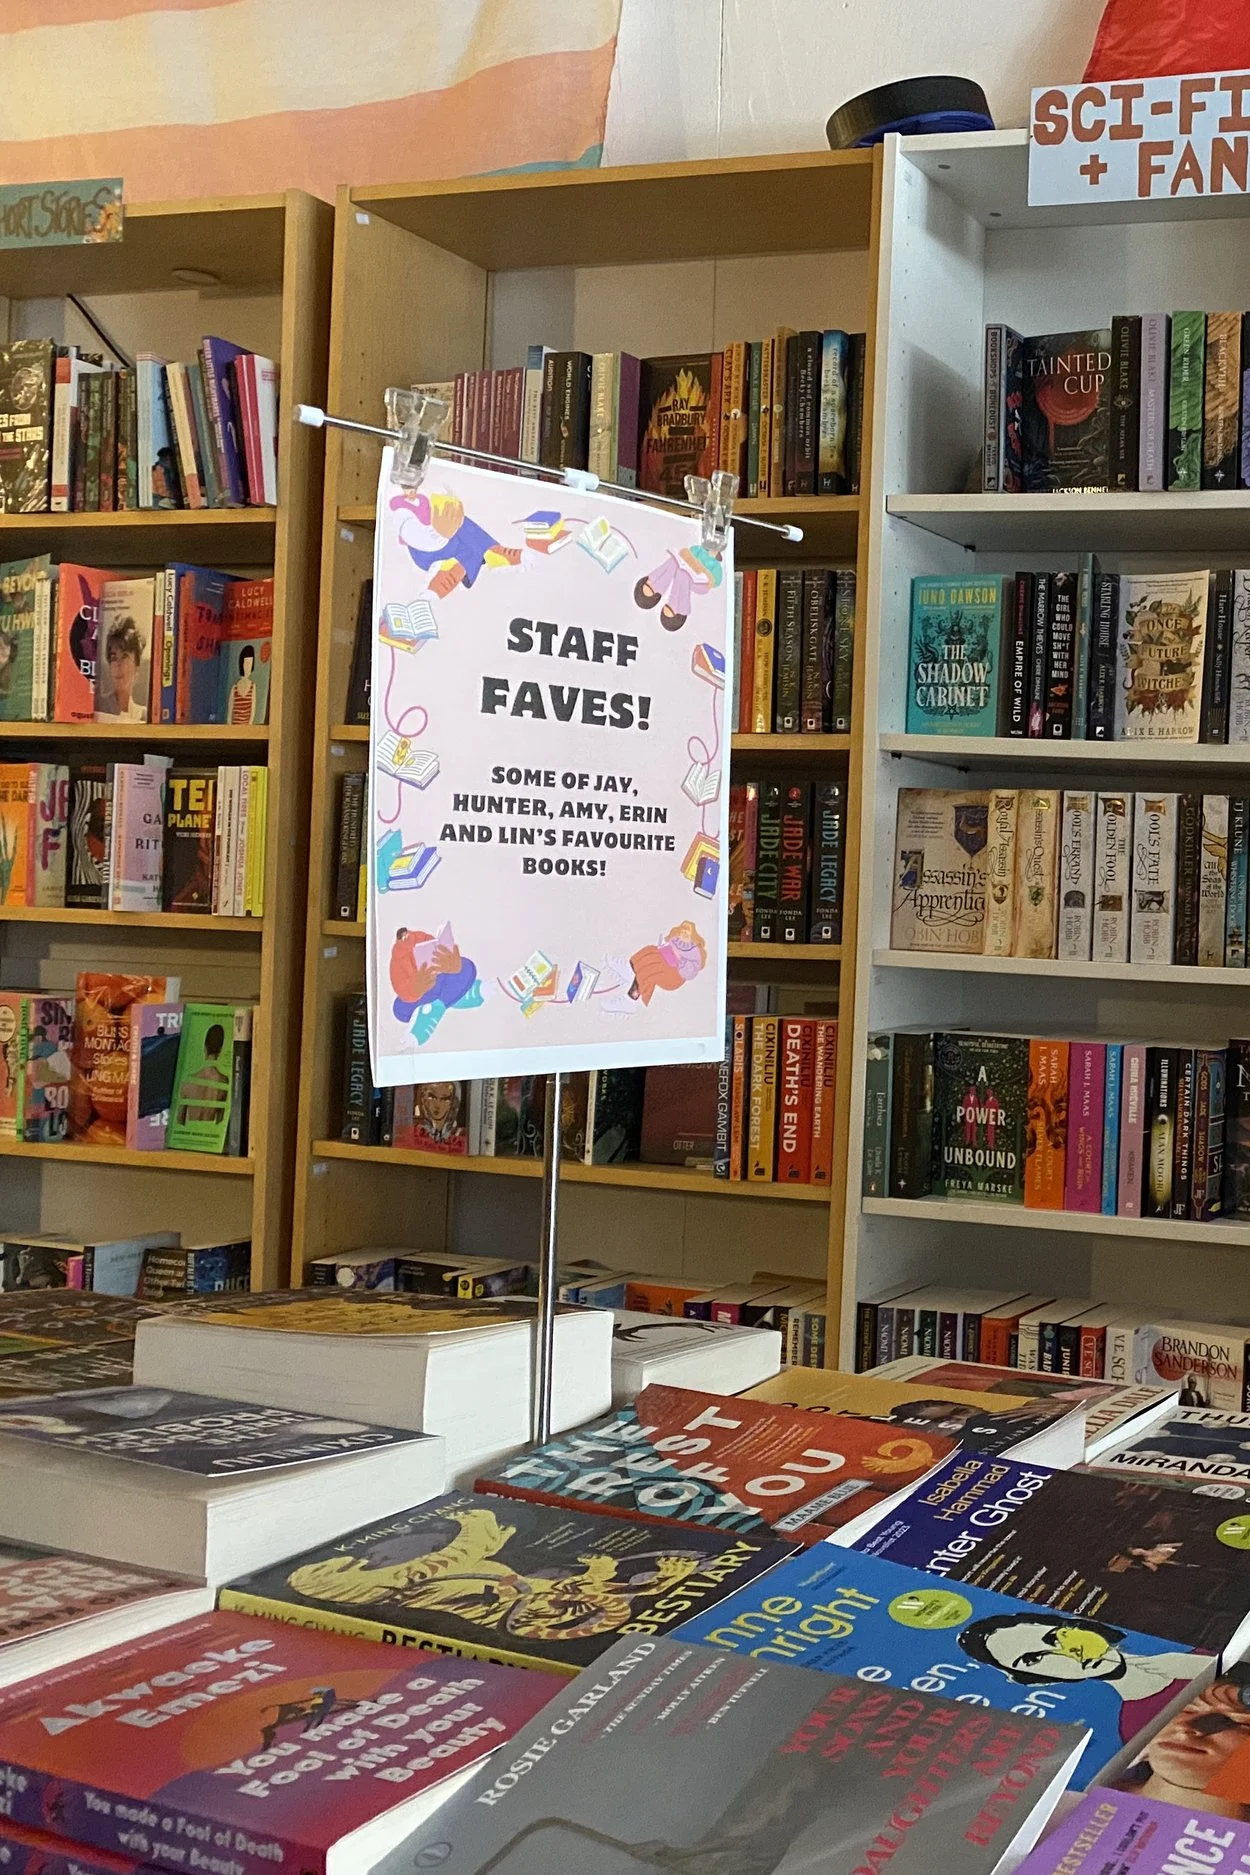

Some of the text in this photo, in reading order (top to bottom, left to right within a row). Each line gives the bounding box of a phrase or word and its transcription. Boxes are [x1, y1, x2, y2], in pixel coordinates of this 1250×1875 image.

[1079, 154, 1108, 185] +
[1026, 352, 1112, 378] TAINTED
[1063, 374, 1105, 395] CUP
[657, 410, 707, 426] BRADBURY
[673, 397, 690, 411] RAY
[507, 617, 639, 667] STAFF
[943, 644, 966, 660] THE
[917, 662, 989, 684] SHADOW
[1012, 640, 1024, 722] EMPIRE OF WILD
[480, 676, 652, 731] FAVES!
[915, 686, 989, 708] CABINET
[491, 766, 639, 797] SOME OF JAY,
[452, 794, 667, 824] HUNTER, AMY, ERIN
[440, 824, 676, 852] AND LIN'S FAVOURITE
[820, 810, 840, 902] JADE LEGACY
[522, 858, 607, 877] BOOKS!
[783, 1024, 801, 1153] DEATH'S END
[977, 1066, 987, 1083] A
[956, 1106, 1006, 1126] POWER
[944, 1147, 1017, 1170] UNBOUND
[945, 1179, 1013, 1194] FREYA MARSKE
[1153, 1352, 1238, 1381] SANDERSON
[1161, 1336, 1231, 1362] BRANDON
[499, 1420, 658, 1482] THE
[564, 1406, 742, 1499] REST
[636, 1461, 735, 1509] OF
[701, 1447, 847, 1520] YOU
[918, 1459, 984, 1506] Isabella
[933, 1463, 1011, 1522] Hammad
[926, 1471, 1053, 1577] nter Ghost
[618, 1540, 763, 1640] BESTIARY
[39, 1638, 276, 1737] Akwaeke
[115, 1661, 287, 1729] Emezi
[214, 1678, 437, 1776] You made a
[236, 1678, 486, 1798] Fool of Death
[324, 1702, 484, 1780] with your
[473, 1642, 656, 1806] ROSIE GARLAND
[374, 1717, 506, 1783] Beauty
